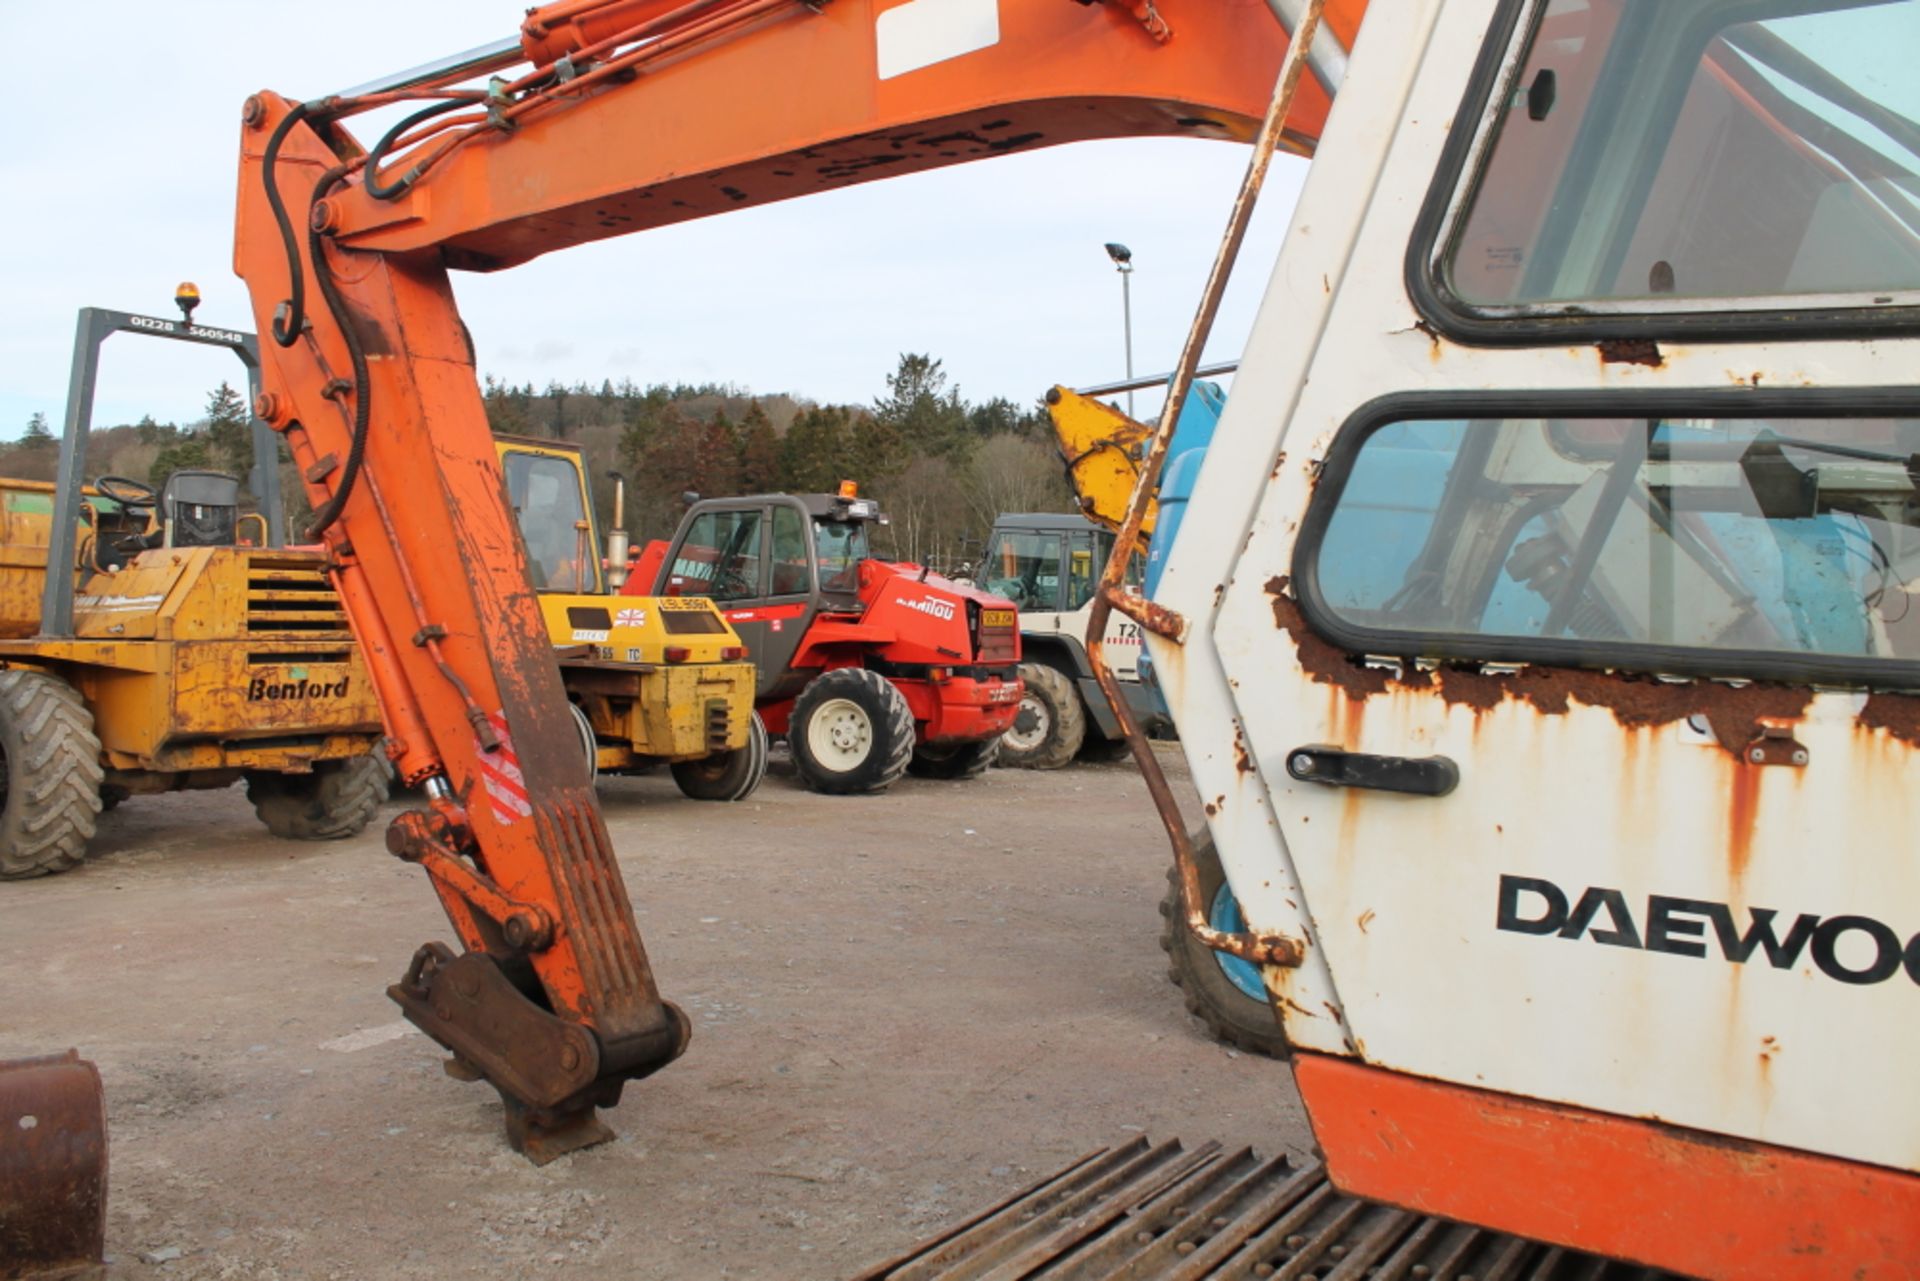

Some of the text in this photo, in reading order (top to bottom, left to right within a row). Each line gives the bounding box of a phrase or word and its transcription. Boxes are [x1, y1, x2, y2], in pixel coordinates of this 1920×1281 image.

[130, 316, 243, 342] 01228 560548
[247, 675, 350, 702] Benford
[1497, 874, 1920, 986] DAEWO
